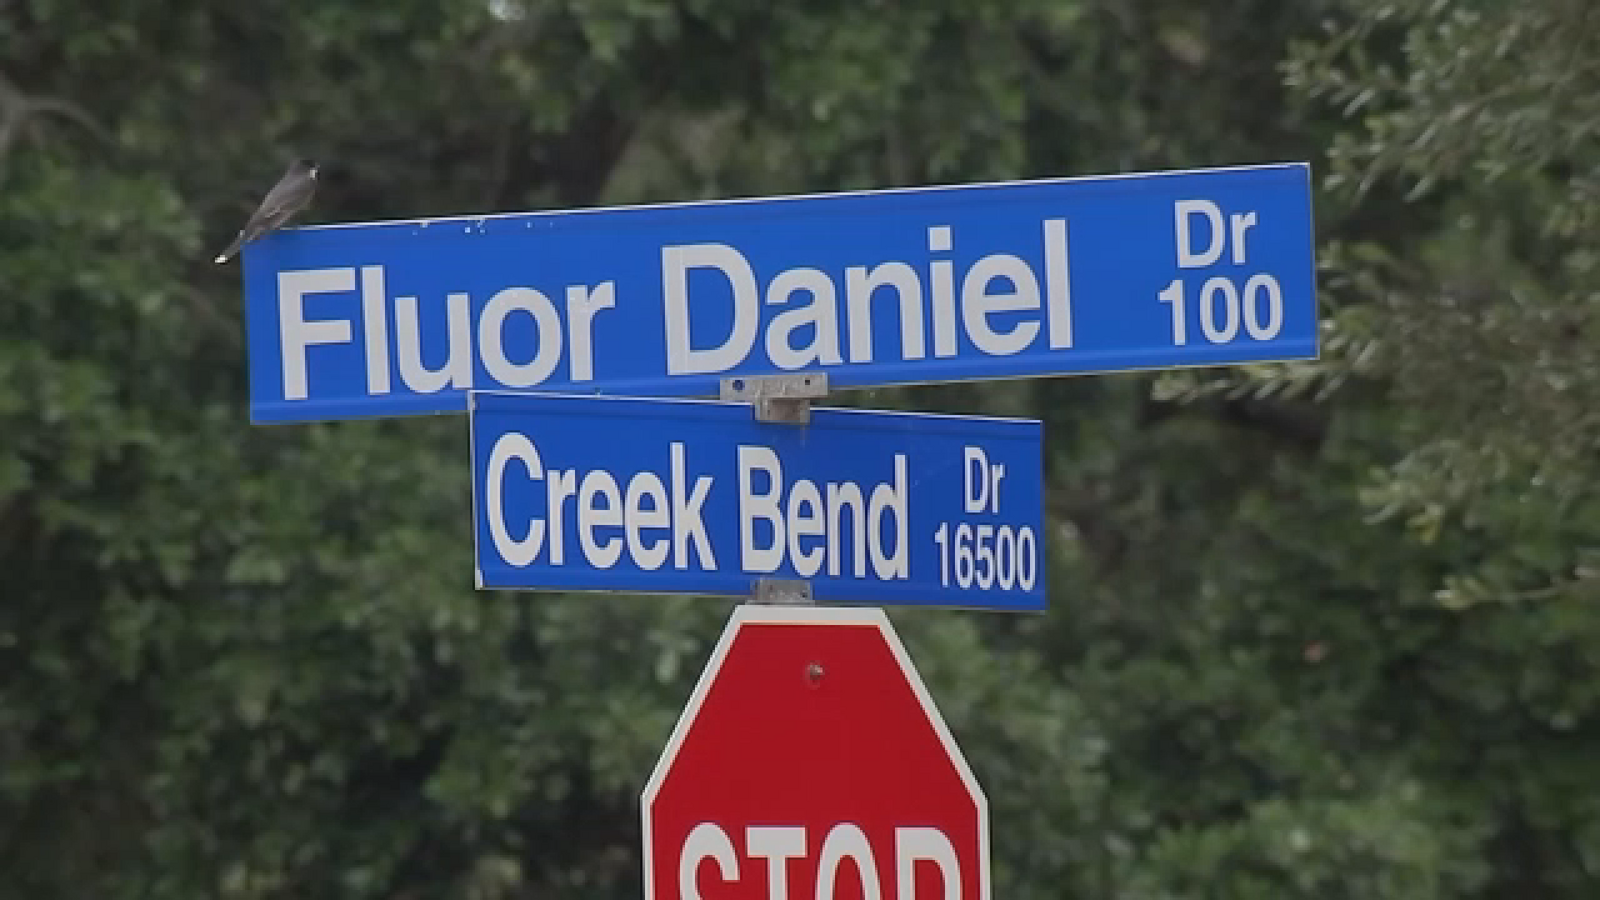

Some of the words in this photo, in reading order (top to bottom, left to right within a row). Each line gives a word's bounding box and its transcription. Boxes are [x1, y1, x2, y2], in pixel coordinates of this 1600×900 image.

[1174, 199, 1257, 268] Dr
[277, 265, 616, 400] Fluor
[661, 219, 1074, 376] Daniel
[1157, 274, 1283, 346] 100
[486, 432, 716, 571] Creek
[737, 445, 908, 581] Bend
[963, 446, 1006, 514] Dr
[934, 522, 1037, 592] 16500
